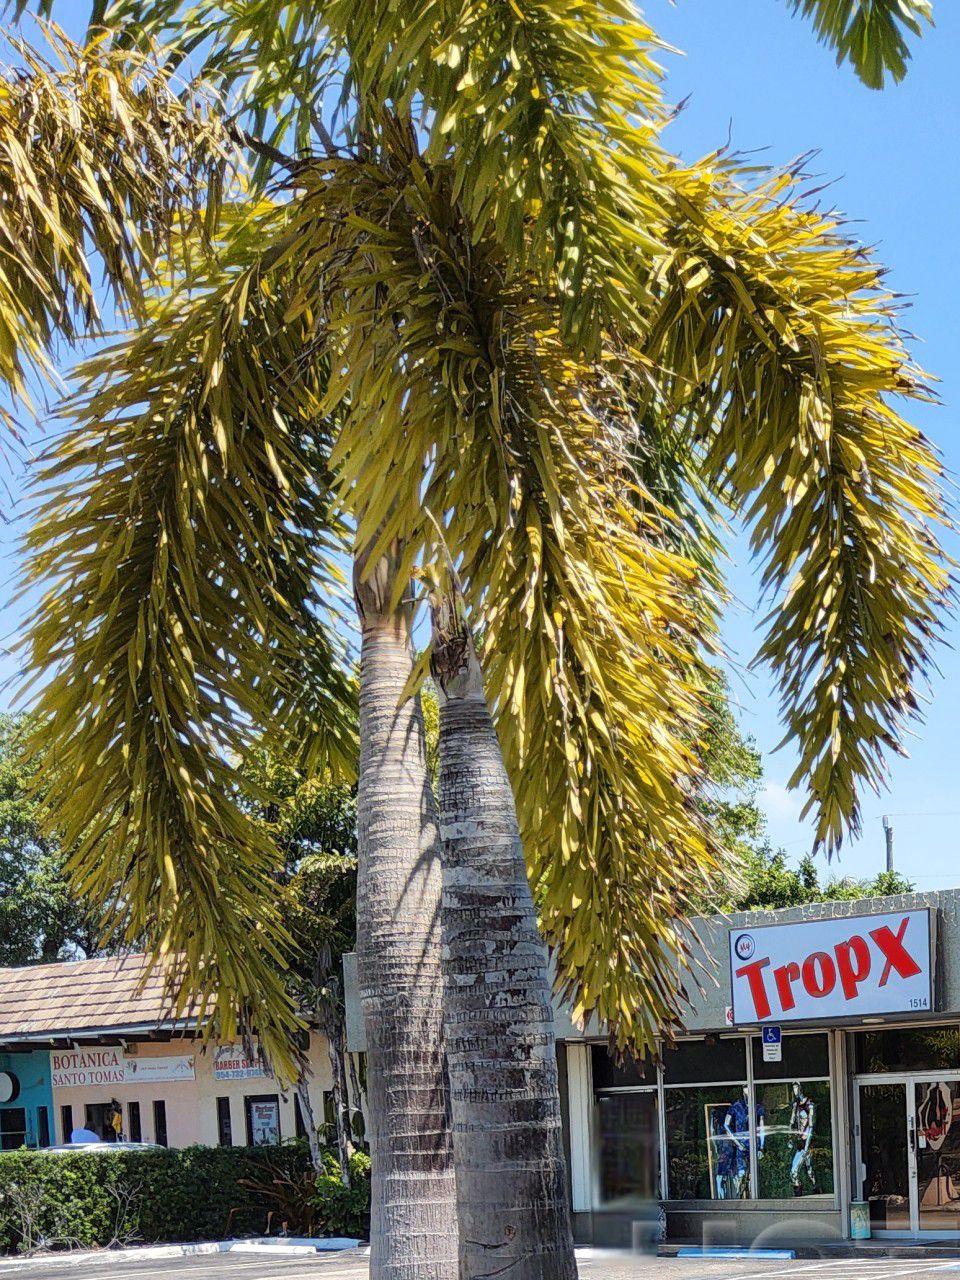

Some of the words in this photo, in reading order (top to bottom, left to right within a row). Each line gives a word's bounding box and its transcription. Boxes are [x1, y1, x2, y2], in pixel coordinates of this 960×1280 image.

[735, 916, 923, 1020] TropX
[909, 998, 928, 1008] 1514
[53, 1051, 120, 1070] BOTANICA
[215, 1060, 240, 1071] BARBER
[53, 1072, 86, 1086] SANTO
[88, 1070, 125, 1084] TOMAS
